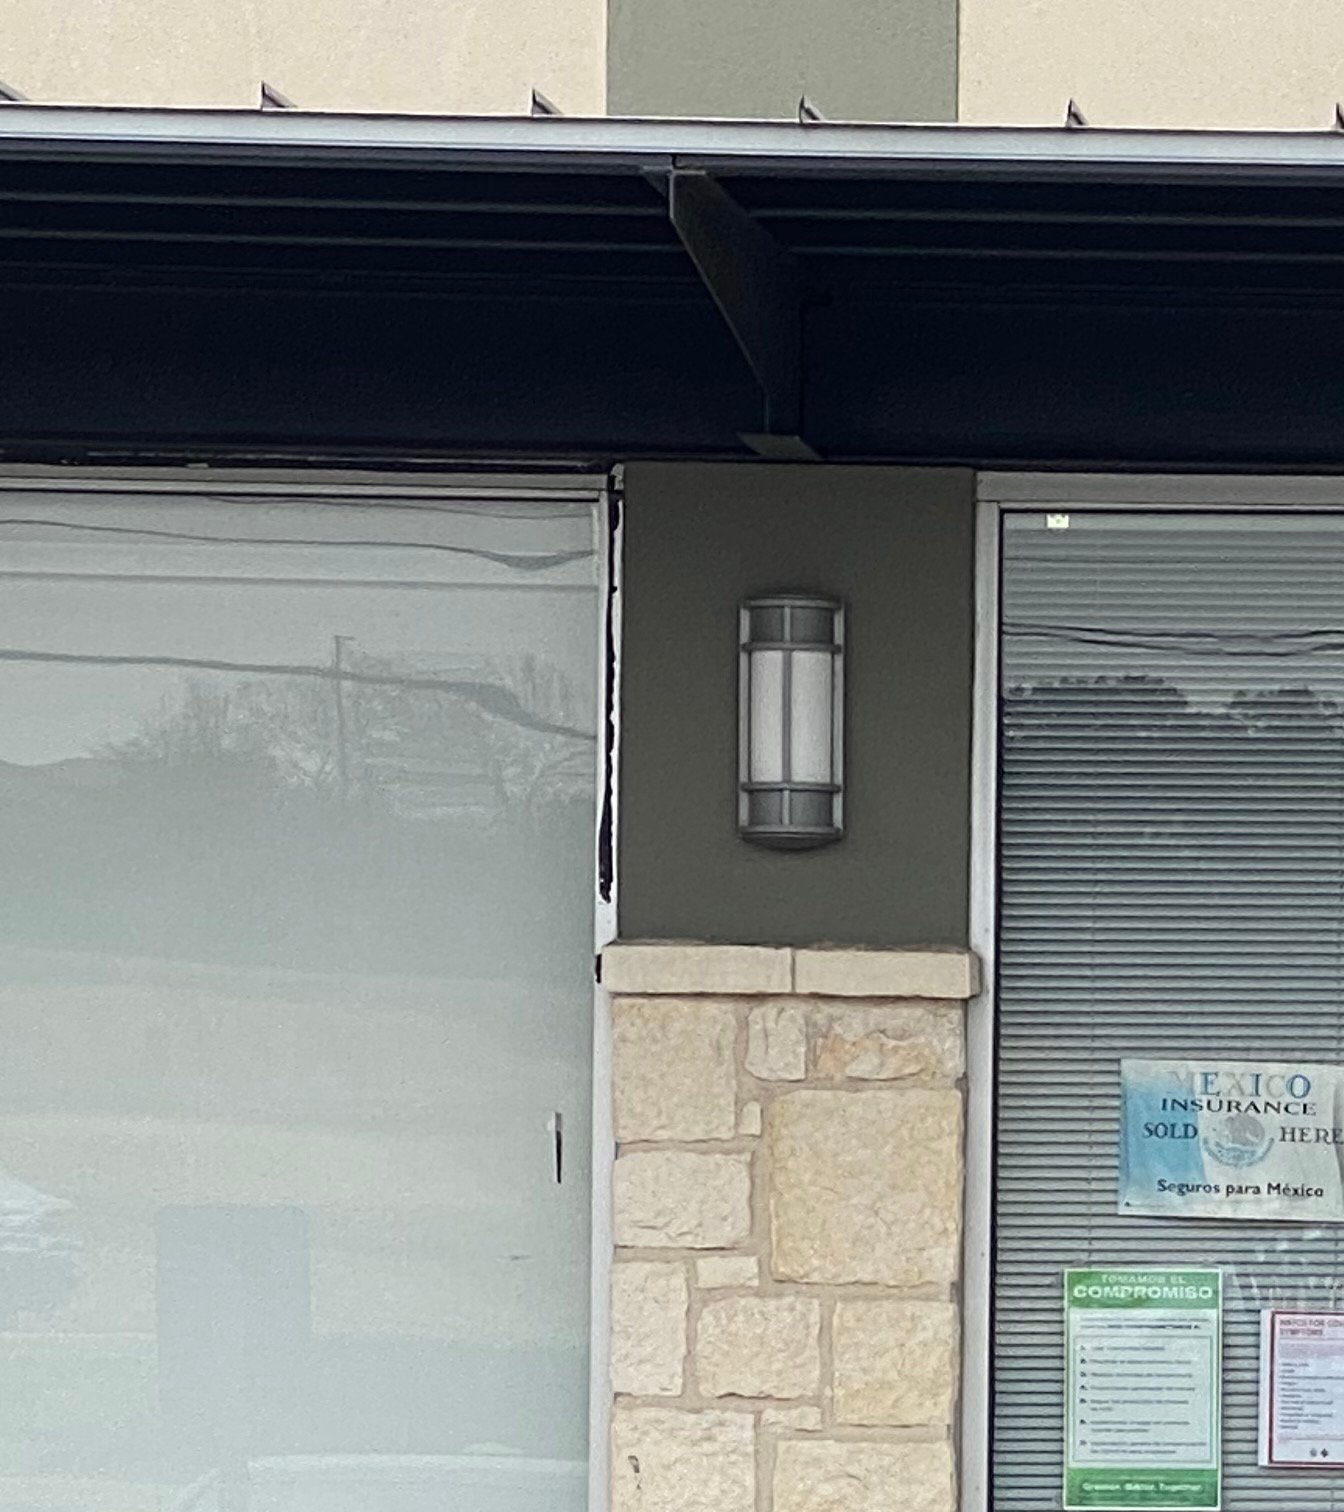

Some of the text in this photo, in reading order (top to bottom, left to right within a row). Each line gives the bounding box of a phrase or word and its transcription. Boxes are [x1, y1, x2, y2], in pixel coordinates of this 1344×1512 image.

[1166, 1071, 1312, 1099] MEXICO
[1160, 1097, 1318, 1117] INSURANCE
[1142, 1121, 1199, 1140] SOLD
[1157, 1178, 1325, 1199] Seguros para México
[1073, 1285, 1213, 1300] COMPROMISO
